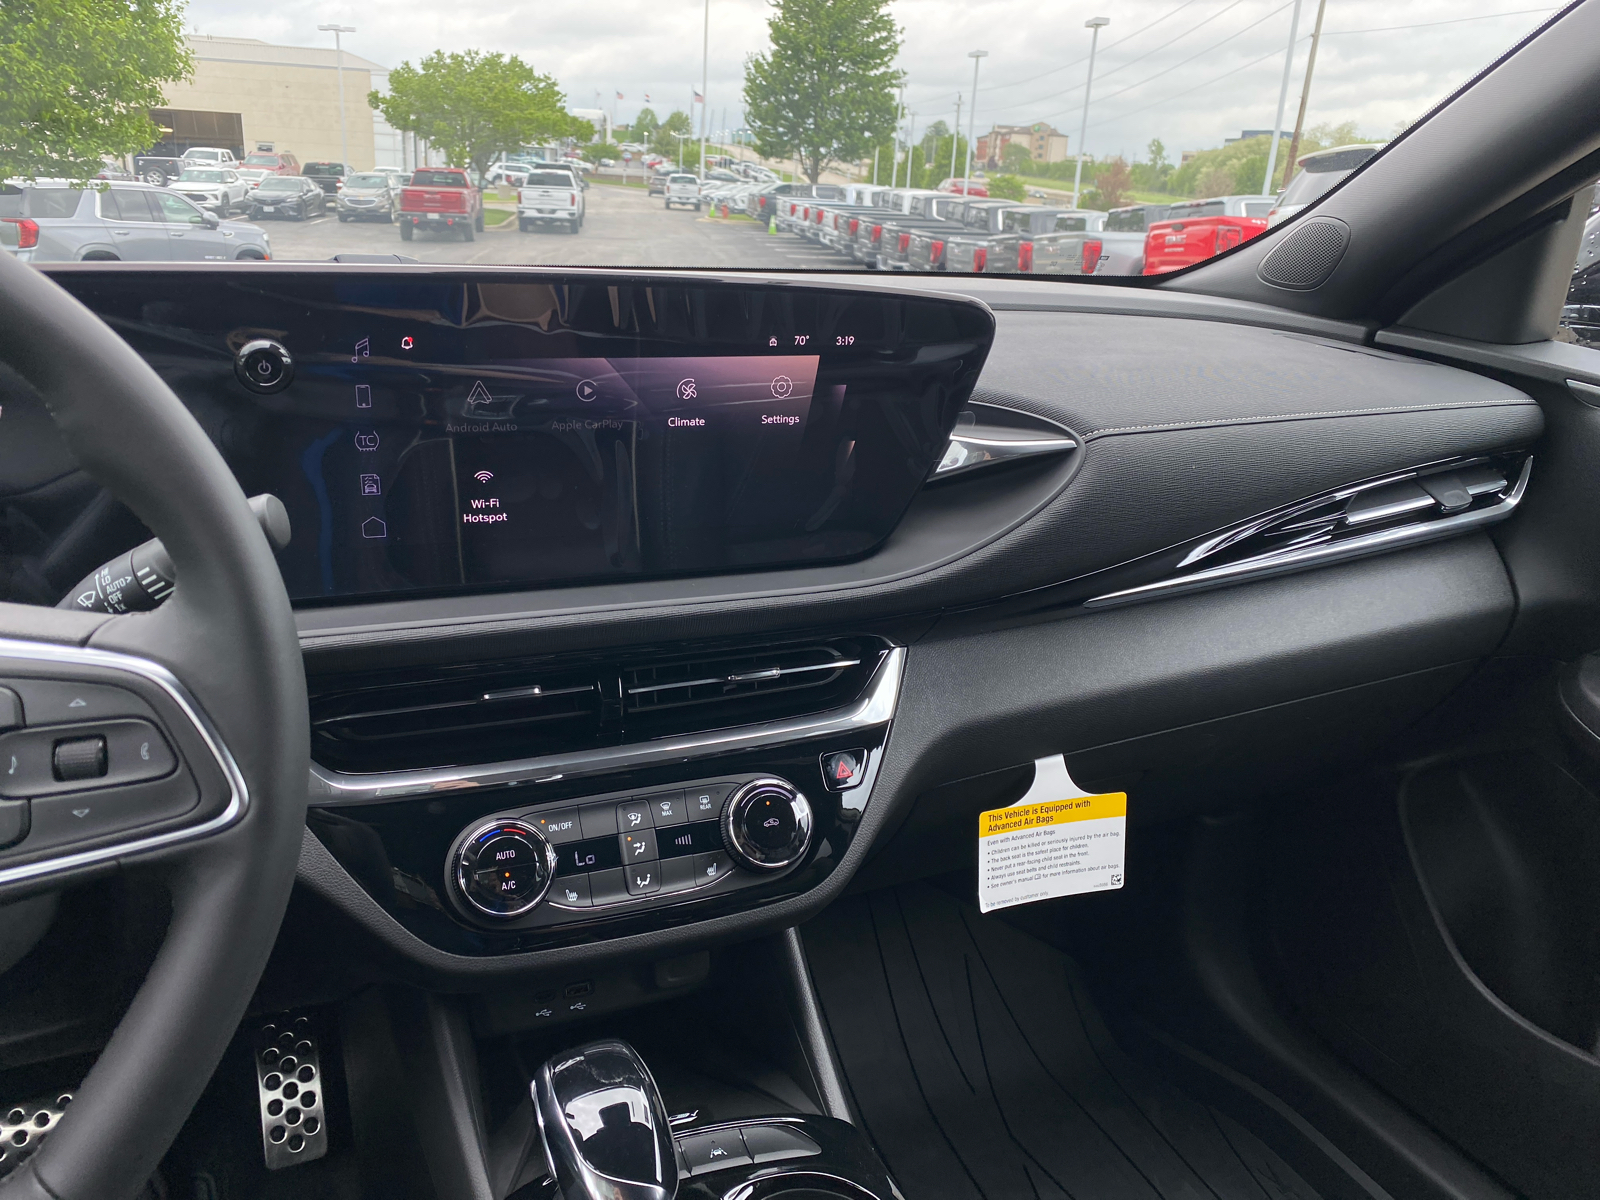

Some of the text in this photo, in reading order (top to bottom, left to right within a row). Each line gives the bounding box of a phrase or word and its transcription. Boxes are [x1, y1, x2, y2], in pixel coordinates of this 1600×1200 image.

[835, 335, 855, 347] 3:19
[551, 418, 624, 432] Apple CarPlay
[667, 416, 706, 428] Climate
[761, 414, 800, 426] Settings
[445, 421, 518, 434] Android Auto
[359, 435, 375, 446] TC
[471, 498, 500, 509] Wi-Fi
[463, 512, 508, 525] Hotspot
[101, 575, 111, 586] LO
[108, 591, 123, 605] OFF
[661, 808, 673, 817] MAX
[699, 802, 712, 811] REAR
[988, 799, 1091, 823] This Vehicle is Equipped with
[548, 821, 573, 833] ON/OFF
[988, 814, 1054, 833] Advanced Air Bags
[987, 839, 999, 847] Even
[1000, 836, 1011, 844] with
[1011, 832, 1035, 842] Advanced
[1043, 829, 1056, 837] Bags
[991, 846, 1011, 856] Children
[1027, 840, 1041, 849] killed
[1047, 837, 1069, 846] seriously
[1069, 834, 1086, 843] injured
[495, 849, 516, 861] AUTO
[574, 851, 596, 867] Lo
[991, 857, 1000, 865] The
[1035, 848, 1049, 856] safest
[1049, 846, 1062, 855] place
[991, 864, 1004, 873] Never
[1016, 858, 1041, 868] rear-facing
[1041, 855, 1053, 863] child
[991, 873, 1007, 882] Always
[1047, 862, 1059, 870] child
[1017, 875, 1034, 884] manual
[1061, 867, 1087, 876] information
[1087, 864, 1100, 872] about
[501, 880, 516, 890] A/C
